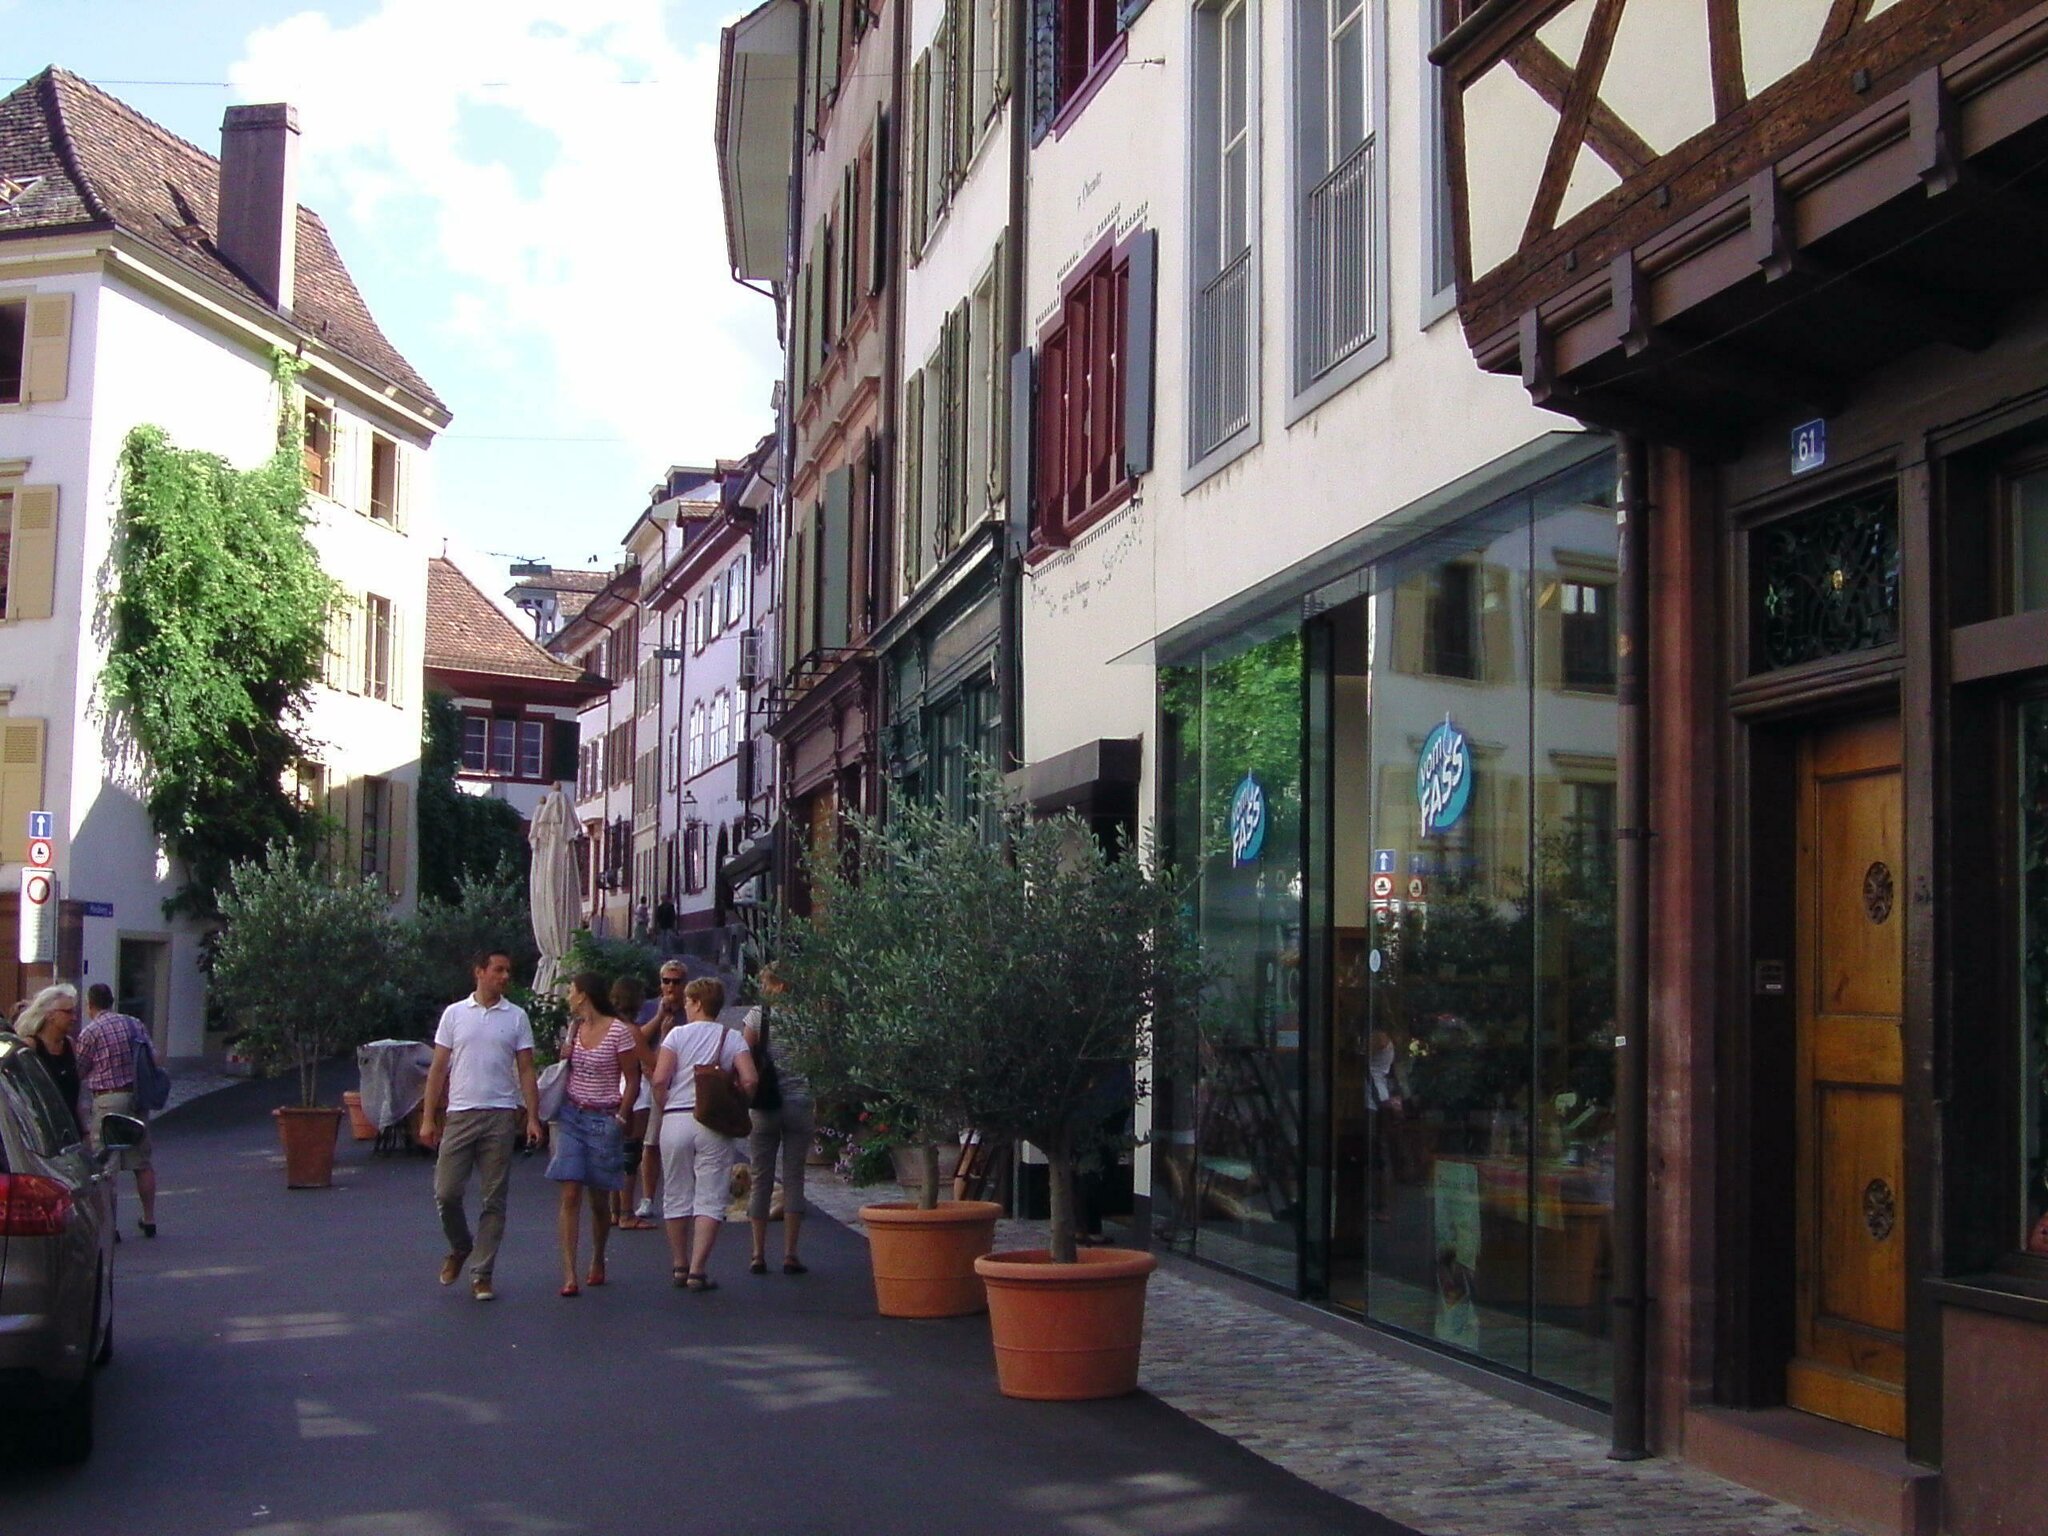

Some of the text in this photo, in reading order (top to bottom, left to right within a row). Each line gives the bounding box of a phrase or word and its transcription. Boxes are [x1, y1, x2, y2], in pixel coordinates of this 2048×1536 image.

[1798, 428, 1815, 462] 61
[1232, 786, 1260, 869] FASS
[1421, 734, 1463, 838] FASS
